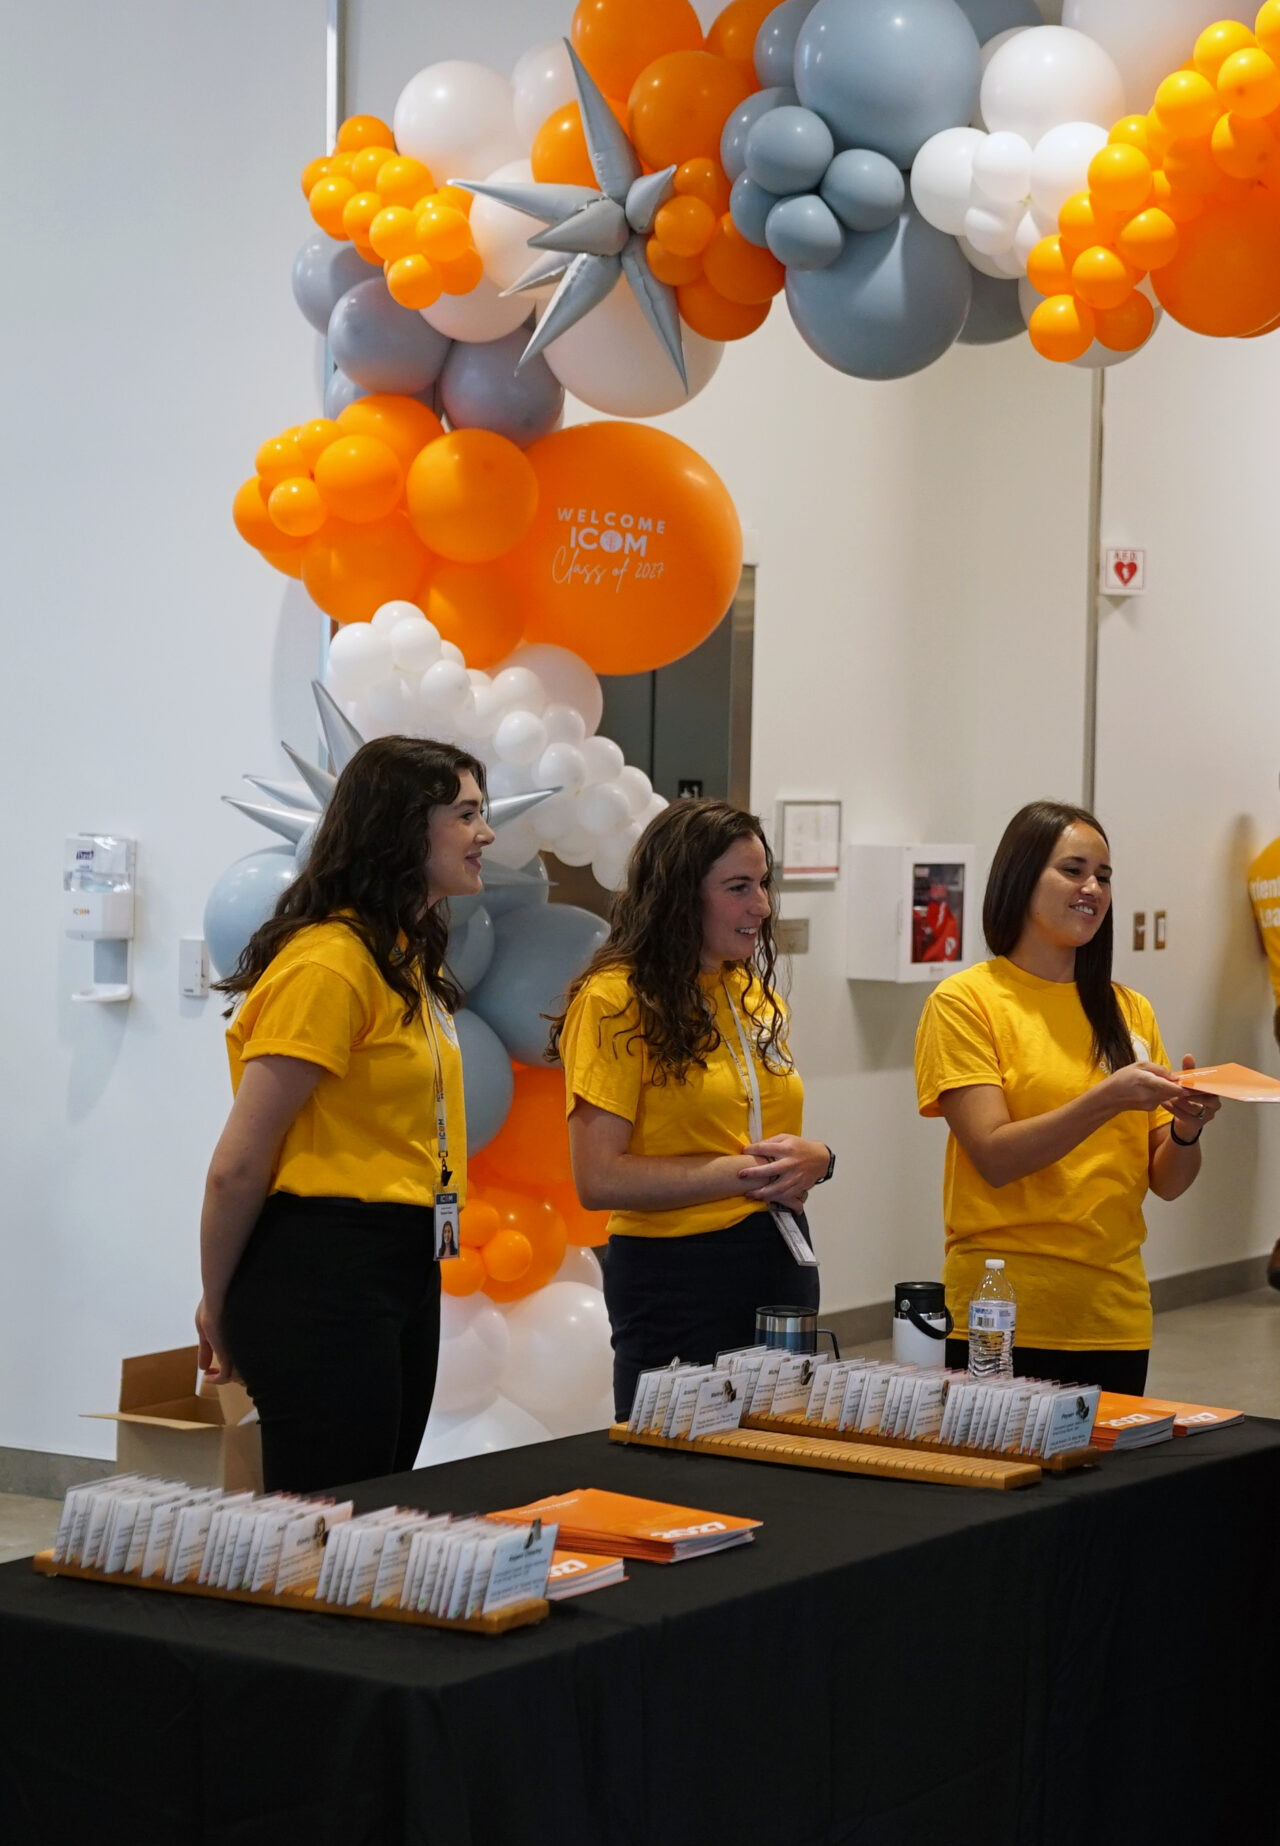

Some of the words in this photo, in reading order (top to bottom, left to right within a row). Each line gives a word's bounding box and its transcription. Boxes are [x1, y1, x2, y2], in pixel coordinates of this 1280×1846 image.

[557, 507, 666, 535] WELCOME
[570, 526, 648, 558] ICOM
[552, 545, 607, 585] Class
[611, 556, 630, 594] of
[634, 561, 664, 579] 2027
